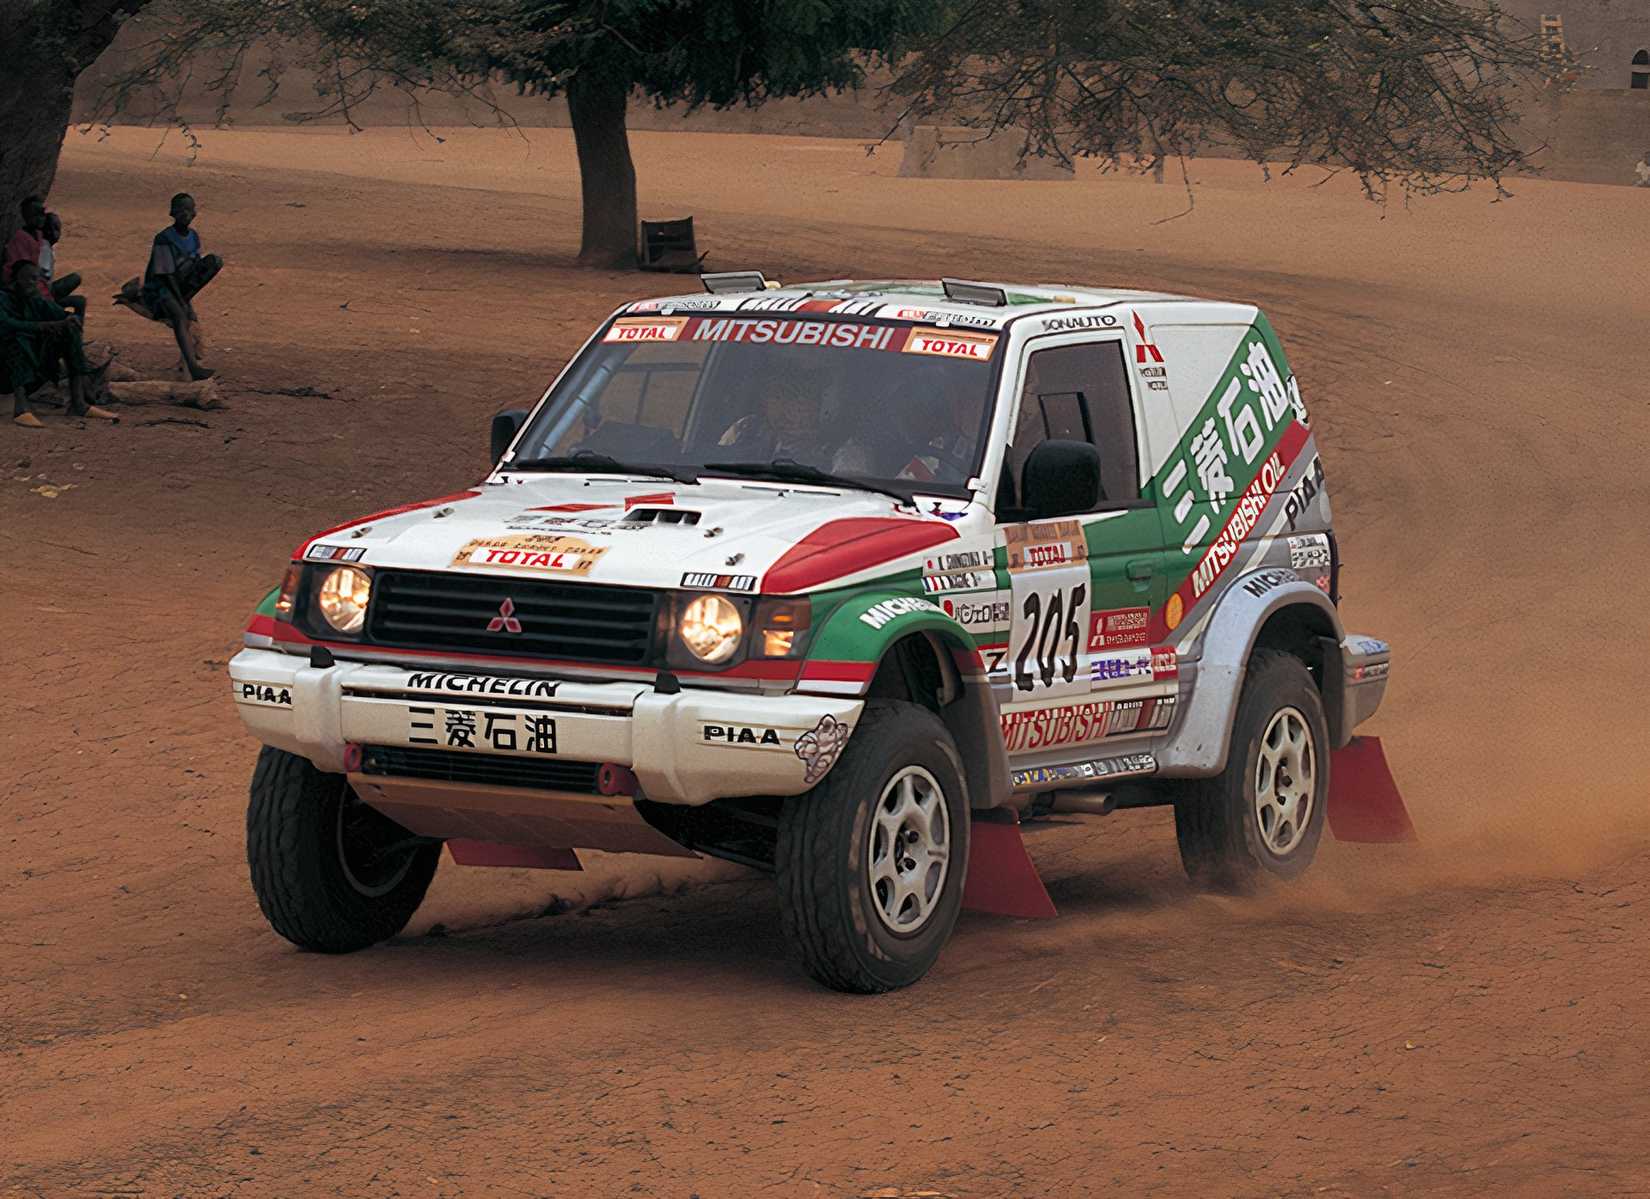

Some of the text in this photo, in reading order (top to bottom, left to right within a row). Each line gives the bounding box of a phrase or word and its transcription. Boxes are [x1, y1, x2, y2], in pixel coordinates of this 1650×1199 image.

[617, 326, 667, 340] TOTAL
[692, 318, 895, 350] MITSUBISHI
[1042, 314, 1117, 332] SONAUTO
[922, 338, 978, 357] TOTAL
[1191, 482, 1269, 599] MITSUBISHI
[1261, 451, 1286, 495] OIL
[485, 549, 565, 568] TOTAL
[1028, 543, 1066, 567] TOTAL
[1015, 582, 1087, 692] 205
[242, 683, 292, 705] PIAA
[407, 672, 561, 698] MICHELIN
[408, 706, 558, 755] 三菱石油
[703, 725, 781, 746] PIAA
